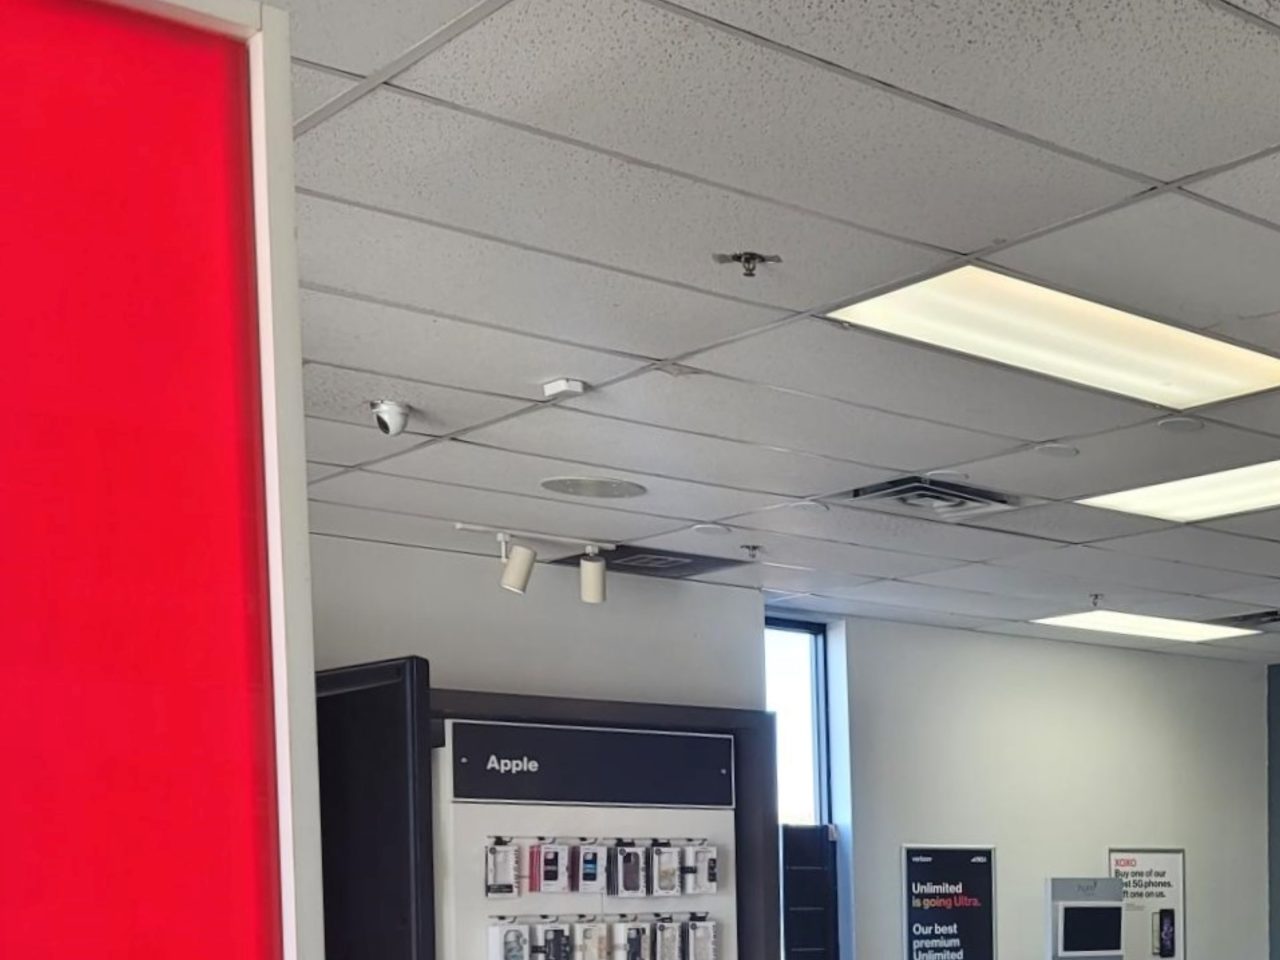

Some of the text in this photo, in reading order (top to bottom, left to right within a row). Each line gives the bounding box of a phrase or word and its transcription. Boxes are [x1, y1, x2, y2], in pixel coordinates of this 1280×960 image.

[486, 754, 539, 774] Apple
[1114, 869, 1129, 879] Buy
[1145, 869, 1153, 878] of
[911, 882, 963, 894] Unlimited
[1132, 880, 1143, 889] 5G
[1144, 880, 1174, 890] phones.
[911, 895, 982, 909] is going Ultra.
[912, 922, 958, 935] Our best
[912, 936, 961, 950] premium
